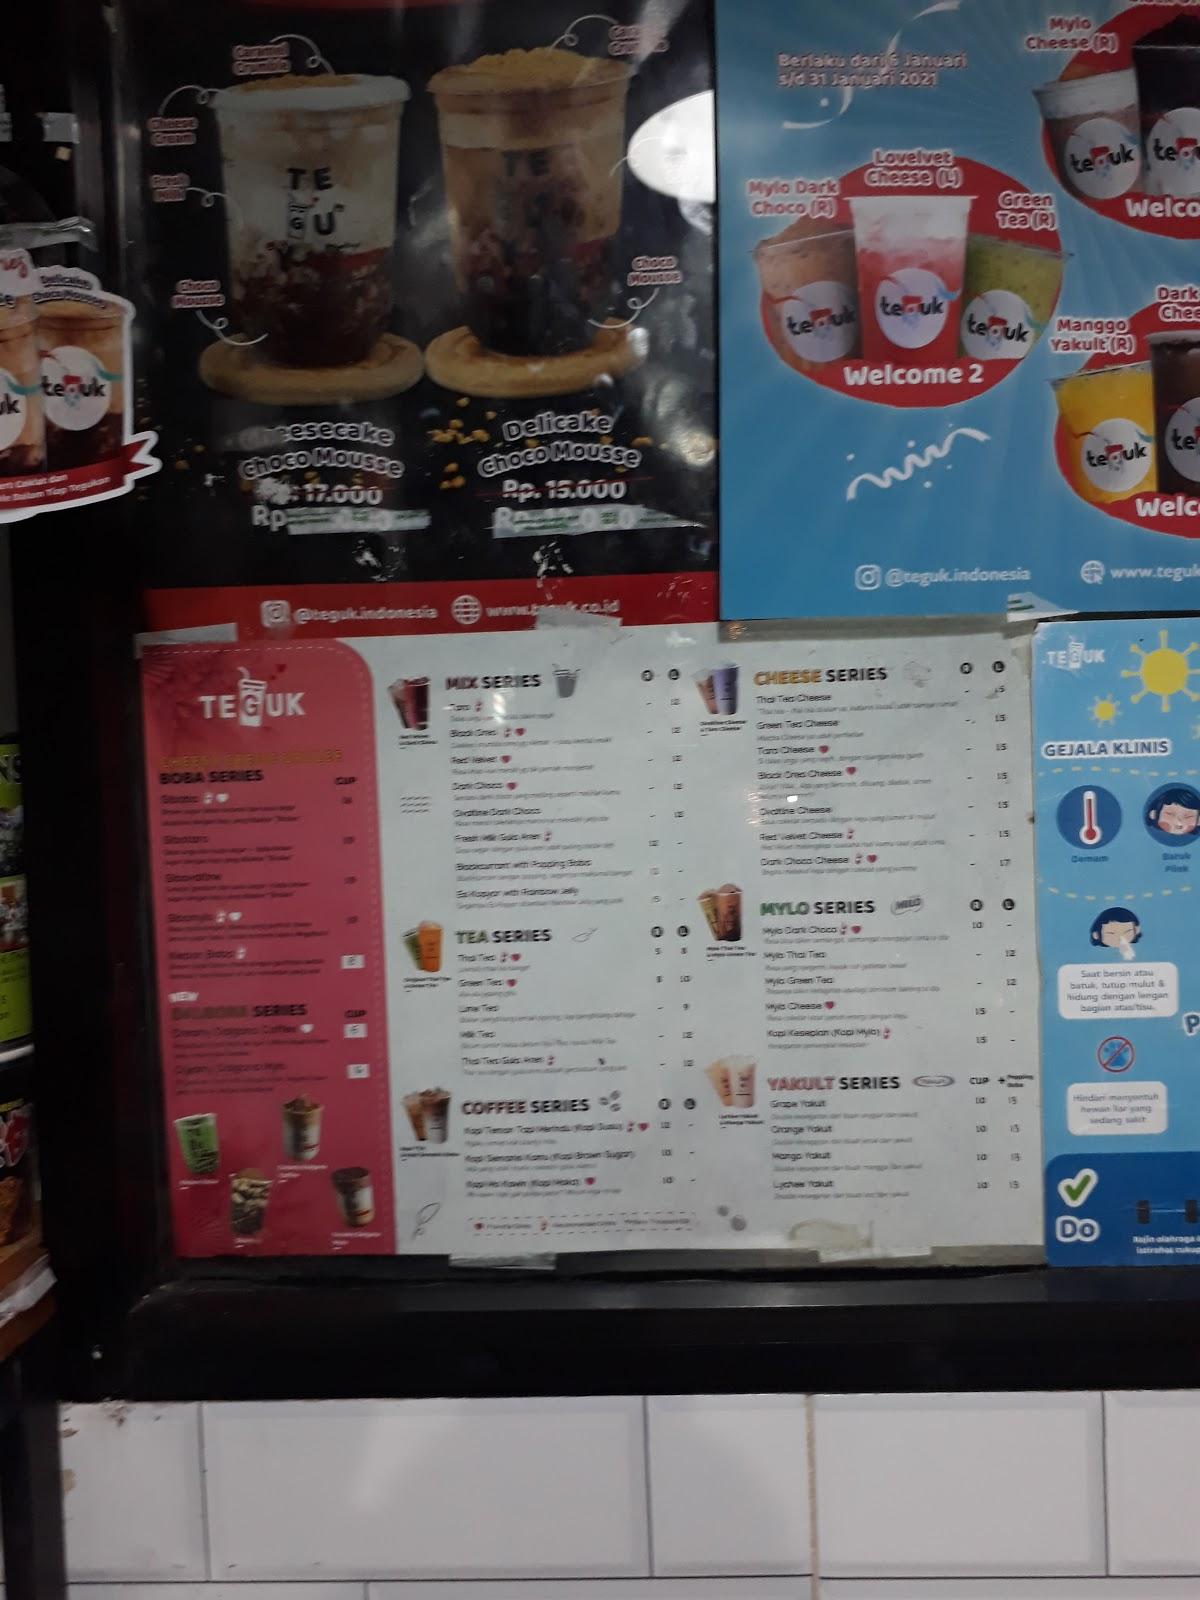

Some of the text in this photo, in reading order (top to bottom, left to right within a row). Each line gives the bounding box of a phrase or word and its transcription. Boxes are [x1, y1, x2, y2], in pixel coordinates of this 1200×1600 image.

[1049, 17, 1092, 32] Mylo
[1025, 36, 1090, 51] Cheese
[777, 53, 846, 68] Berlaku
[903, 53, 968, 69] Januari
[809, 73, 828, 86] 31
[899, 71, 938, 86] 2021
[873, 149, 953, 166] Lovelvet
[864, 169, 933, 187] Cheese
[794, 178, 839, 196] Dark
[751, 199, 806, 216] Choco
[999, 191, 1054, 209] Green
[1158, 286, 1198, 300] Dark
[1056, 318, 1127, 336] Manggo
[1051, 338, 1107, 352] Yakult
[845, 364, 984, 386] Welcome 2
[503, 410, 614, 441] Delicake
[549, 441, 642, 468] Mousse
[886, 567, 1031, 587] @teguk.indonesia
[445, 674, 542, 690] MIX SERIES
[754, 667, 888, 686] CHEESE SERIES
[1044, 740, 1169, 758] GEJALA KLINIS
[207, 769, 265, 783] SERIES
[760, 901, 810, 916] MYLO
[813, 900, 875, 915] SERIES
[456, 929, 552, 944] TEA SERIES
[1080, 969, 1155, 978] Saat bersin atau
[1101, 980, 1127, 991] tutup
[1128, 979, 1155, 988] mulut
[1066, 990, 1169, 1002] hidung dengan lengan
[252, 1003, 308, 1018] SERIES
[1079, 1004, 1112, 1014] bagian
[767, 1076, 900, 1091] YAKULT SERIES
[969, 1076, 990, 1086] CUP
[463, 1099, 591, 1115] COFFEE SERIES
[1080, 1104, 1110, 1113] hewan
[1089, 1116, 1122, 1126] sedang
[1059, 1218, 1096, 1239] Do
